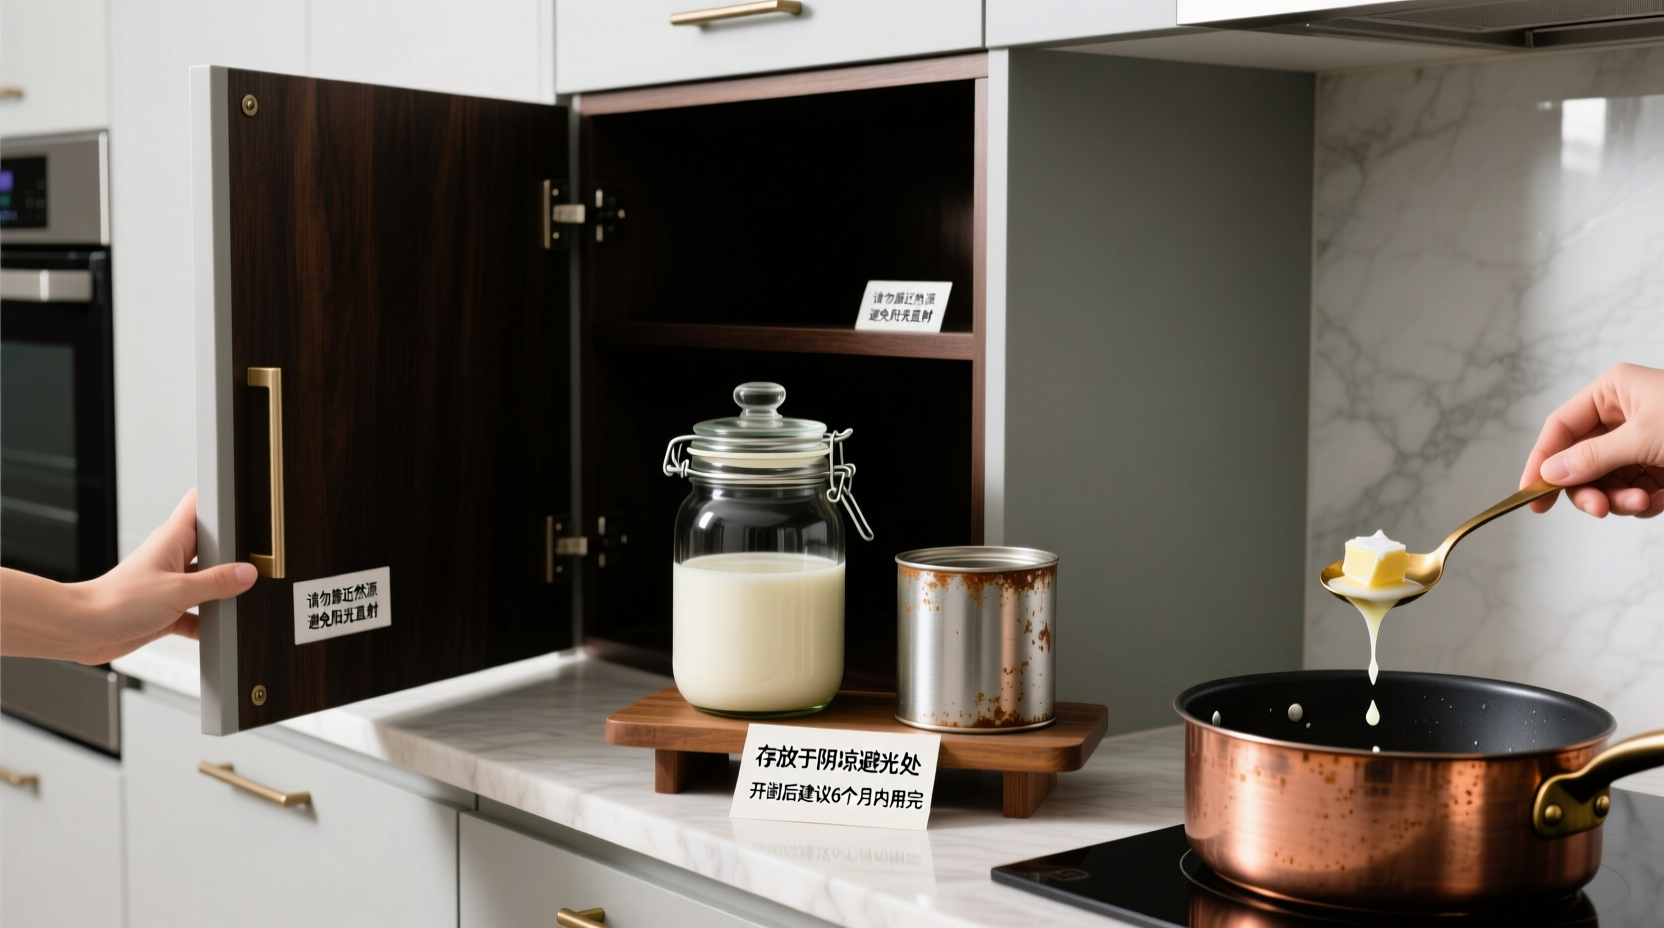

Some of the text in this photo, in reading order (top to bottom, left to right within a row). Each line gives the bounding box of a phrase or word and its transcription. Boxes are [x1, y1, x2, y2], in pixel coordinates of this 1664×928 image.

[755, 744, 922, 776] 存放于阴凉避光处
